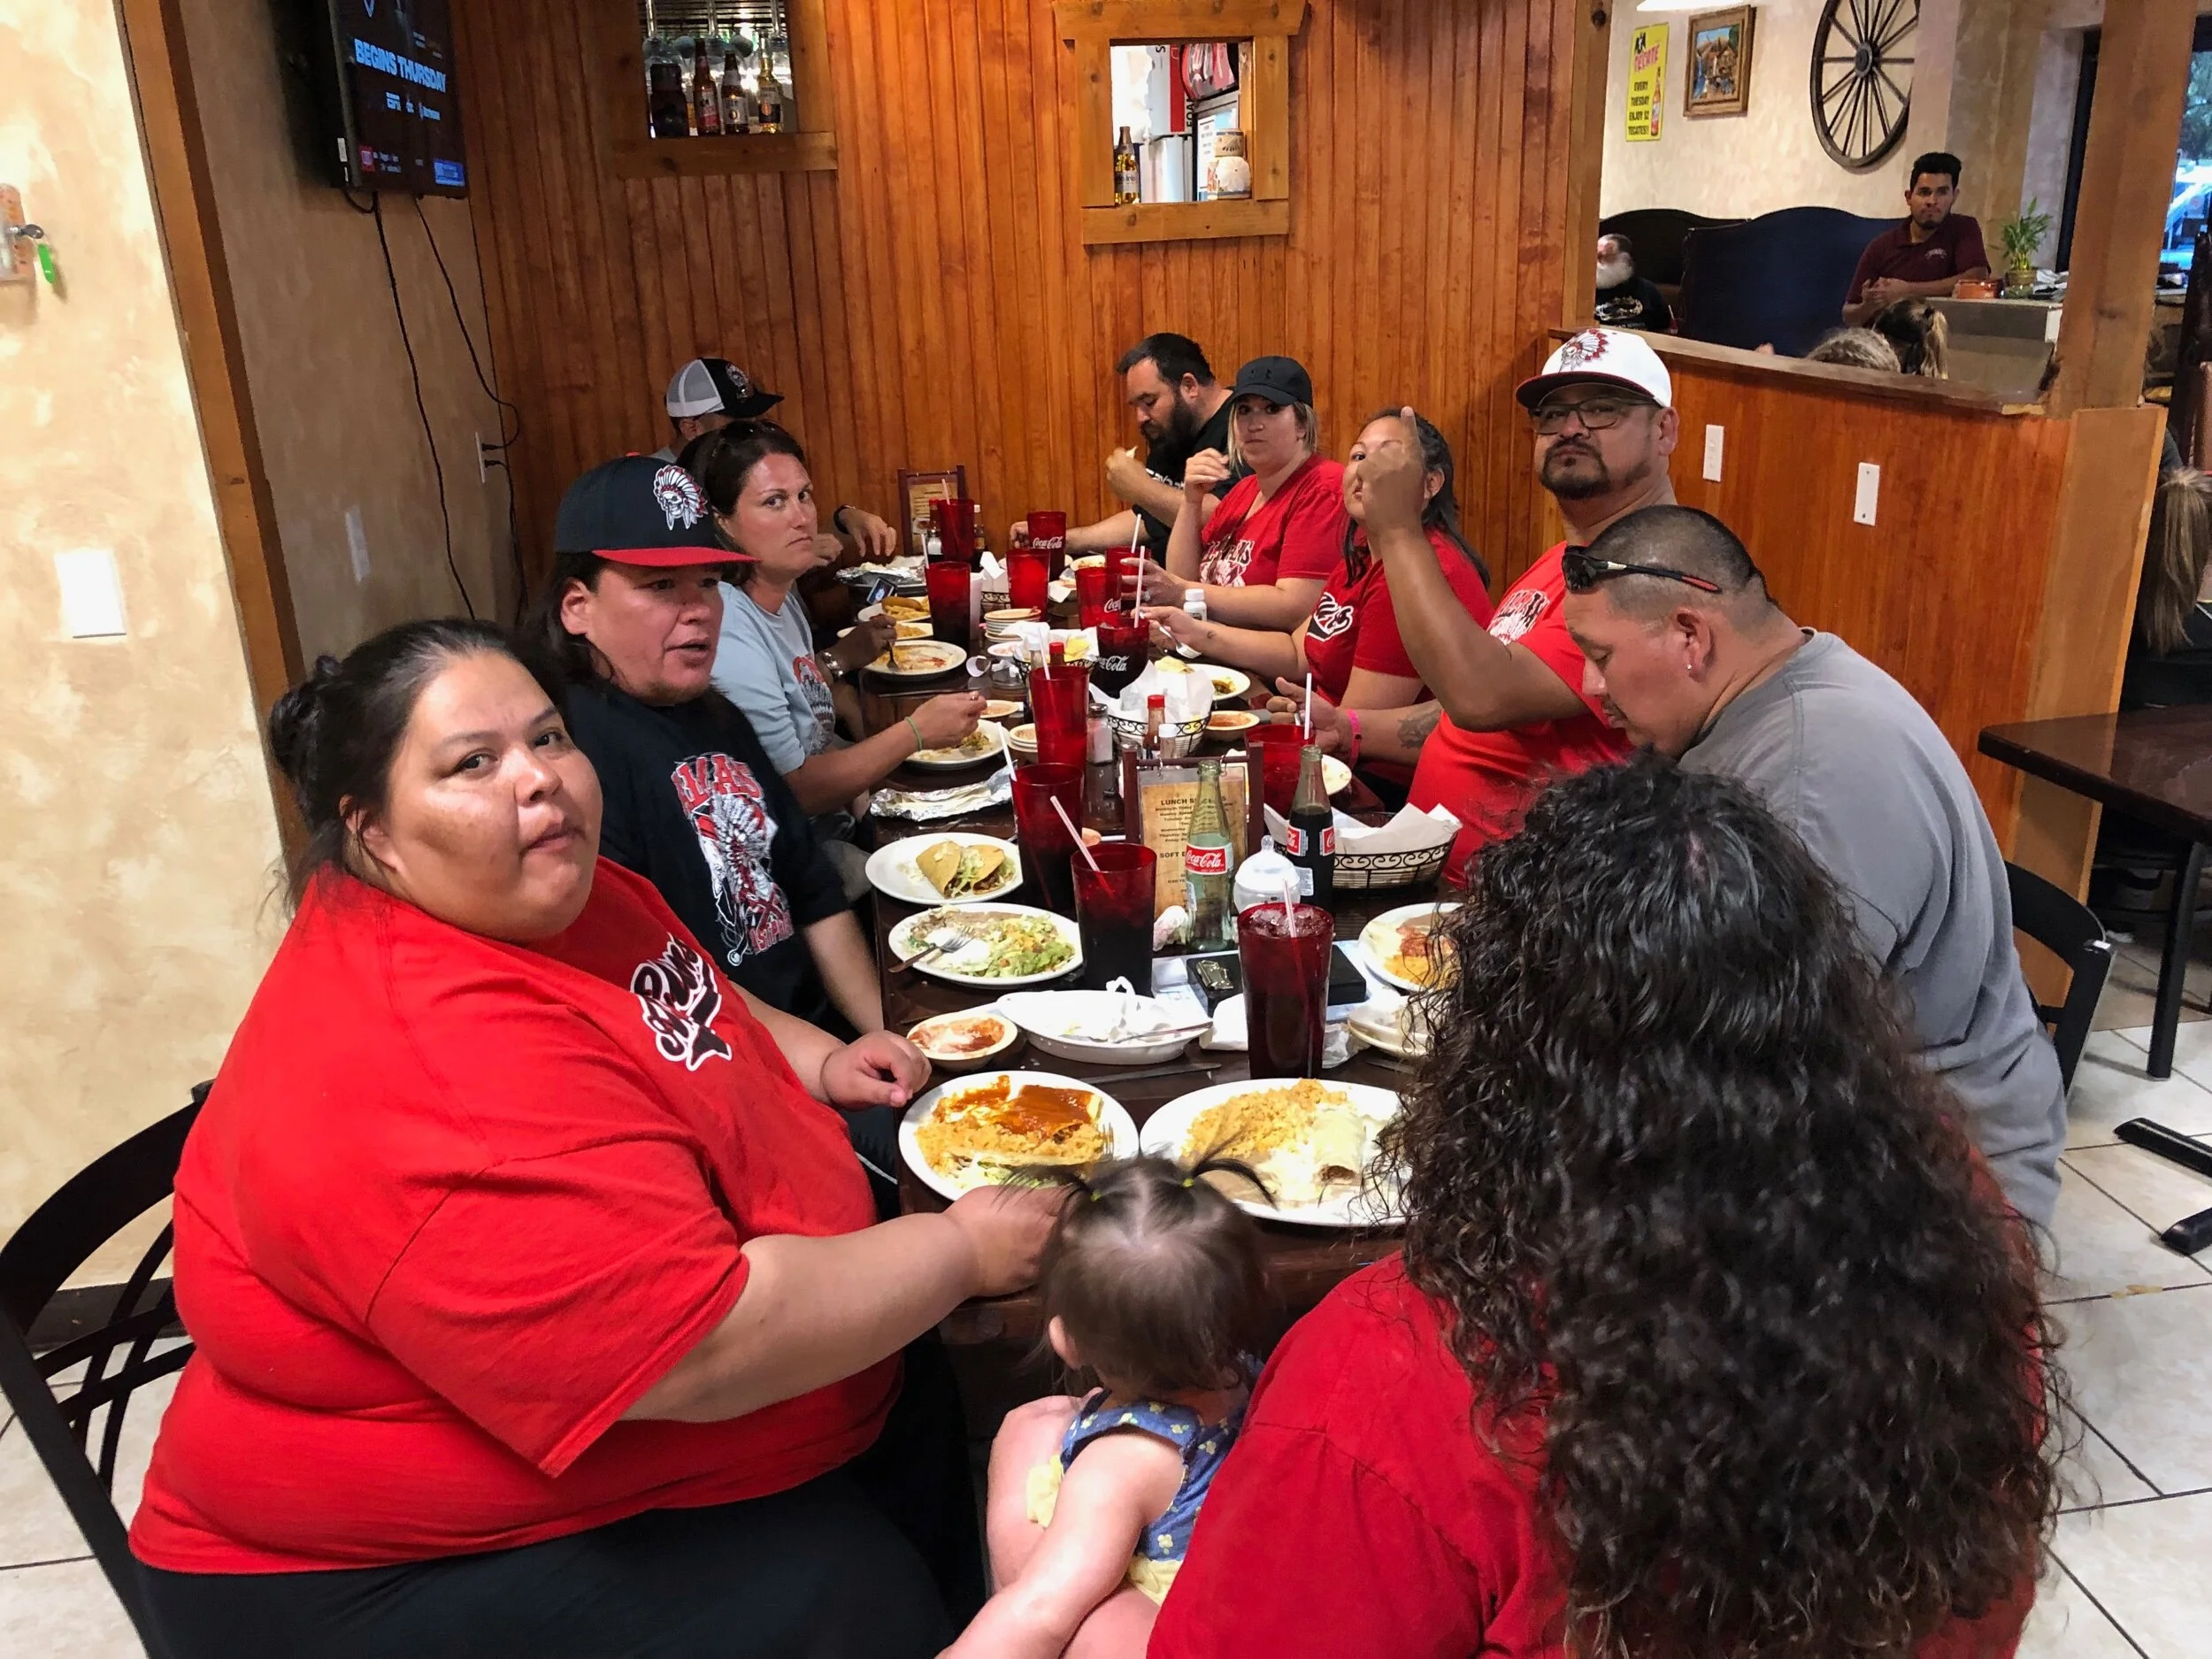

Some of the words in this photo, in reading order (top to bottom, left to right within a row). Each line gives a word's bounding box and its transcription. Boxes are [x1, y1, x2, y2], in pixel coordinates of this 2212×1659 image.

[355, 38, 397, 76] BEGINS
[397, 55, 446, 93] THURSDAY
[1634, 81, 1648, 91] EVERY
[1631, 96, 1649, 106] TUESDAY
[1629, 111, 1643, 121] ENJOY
[1187, 849, 1222, 867] Coca-Cola
